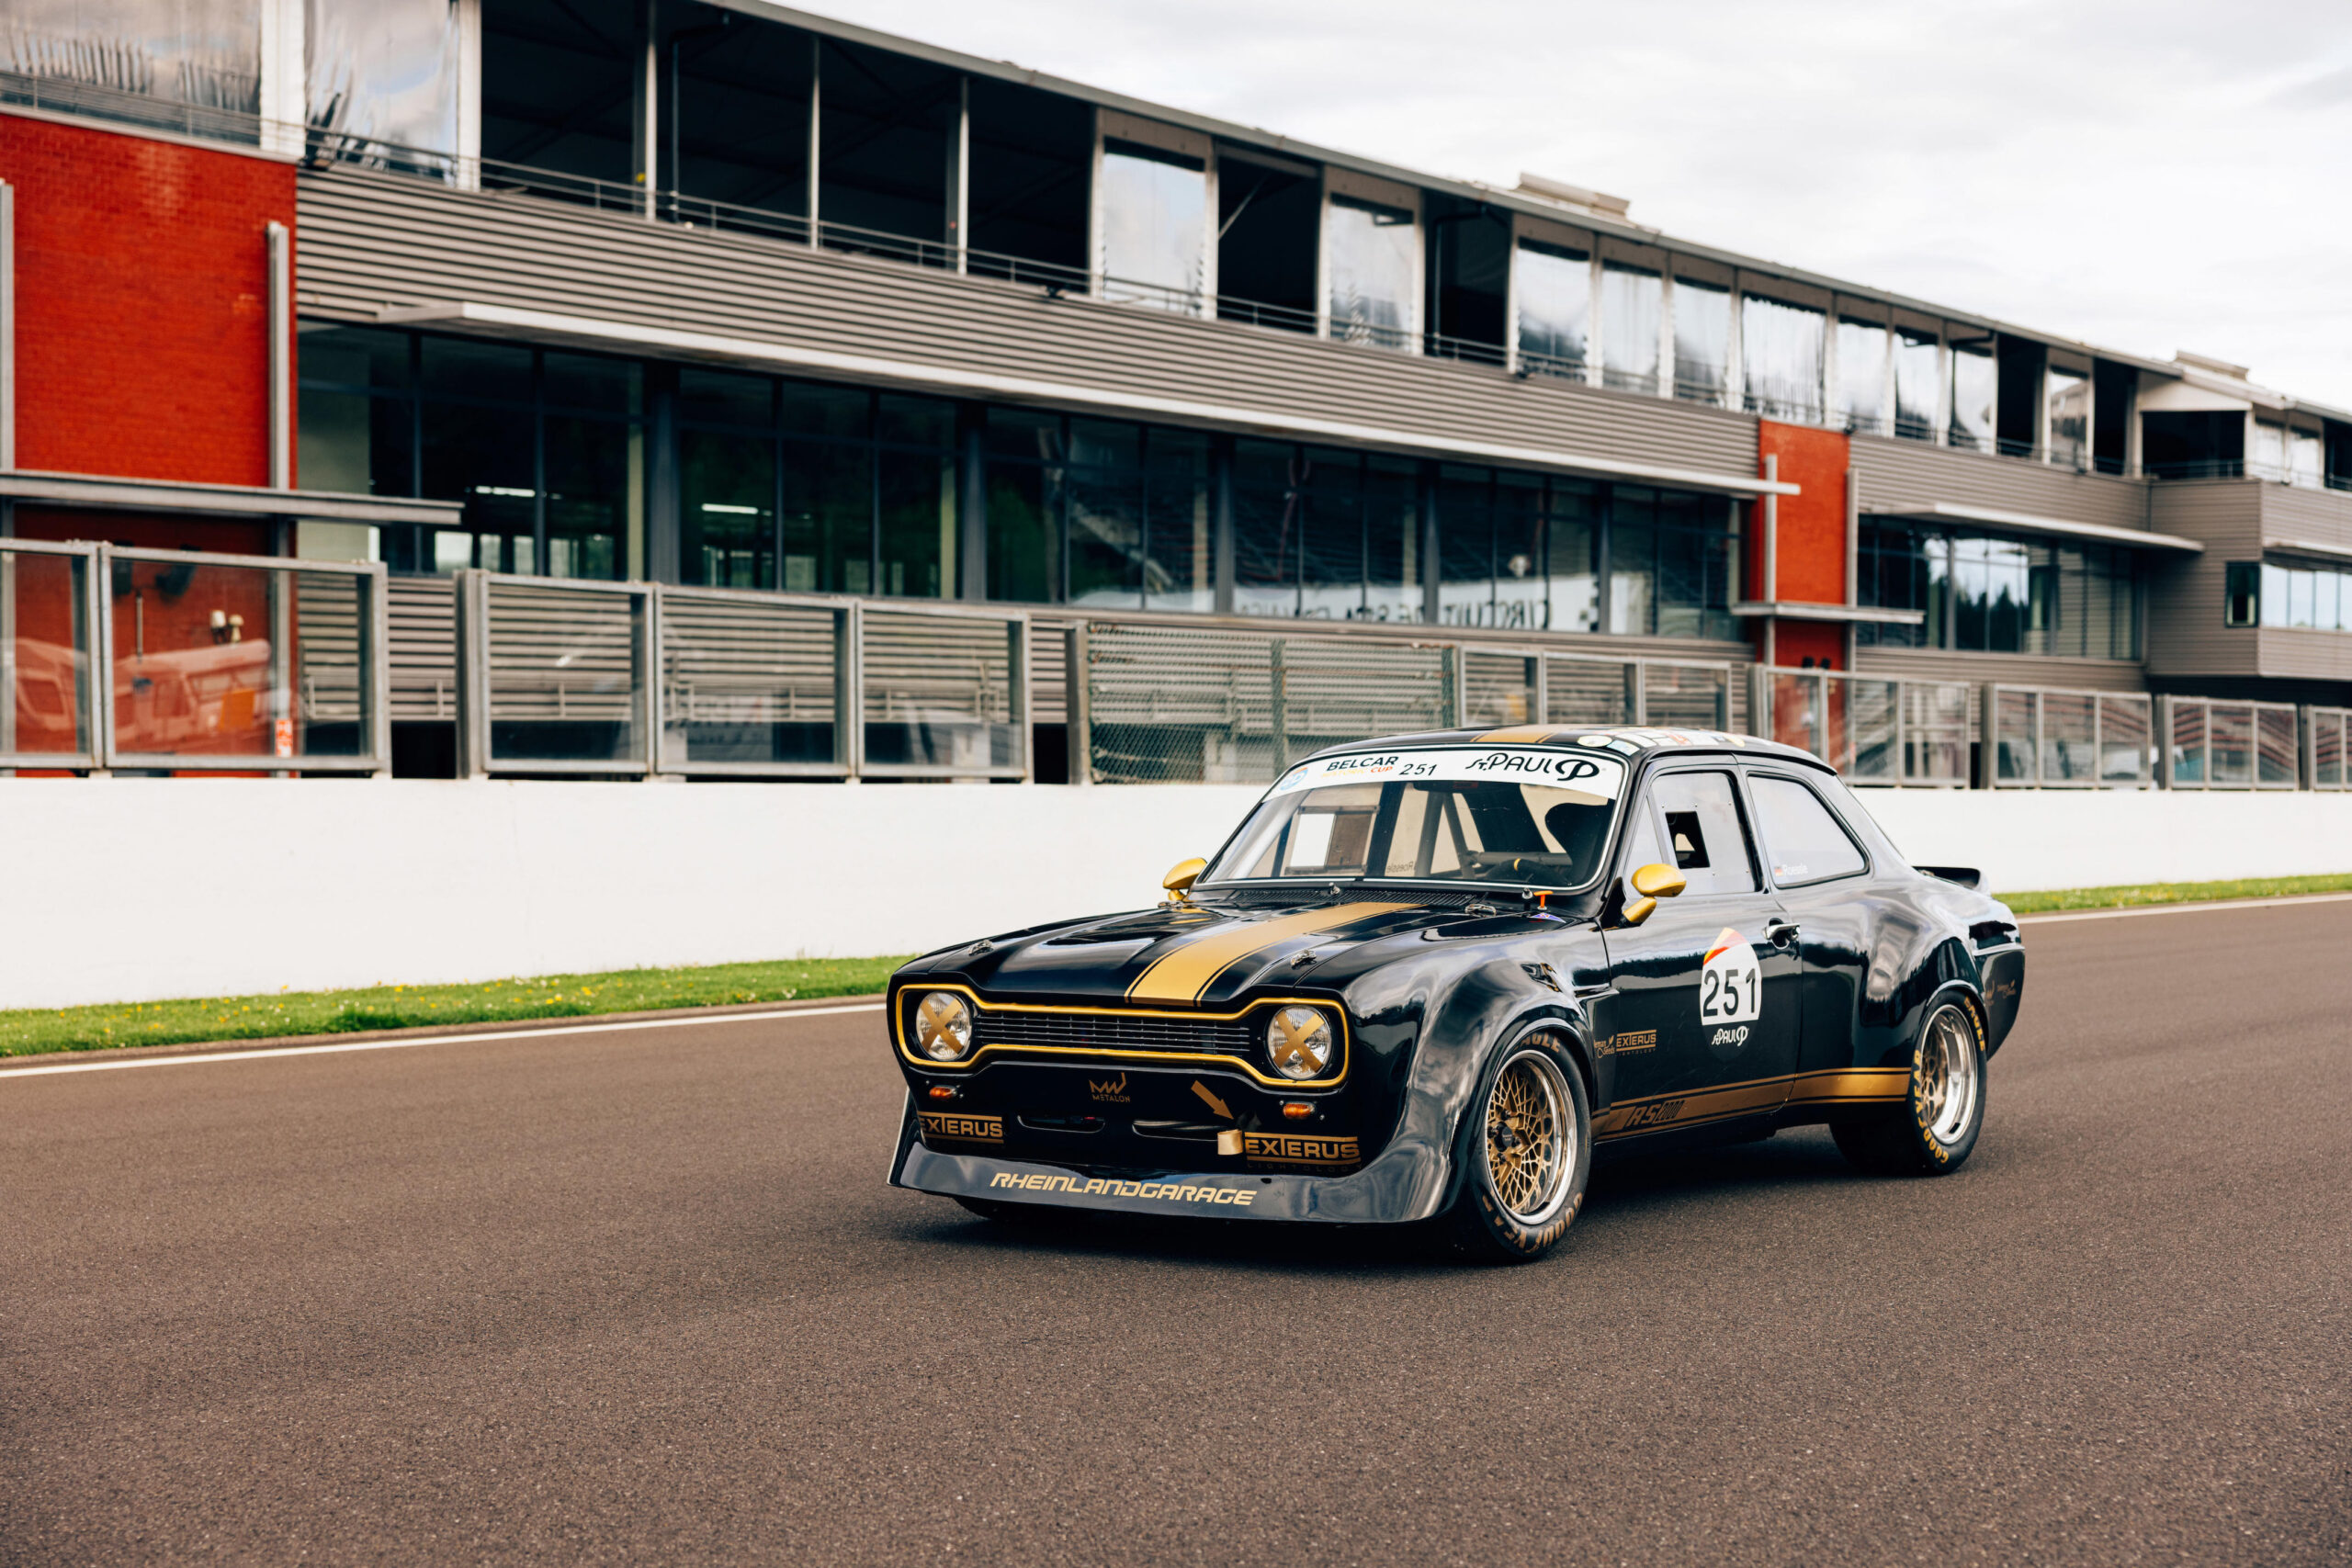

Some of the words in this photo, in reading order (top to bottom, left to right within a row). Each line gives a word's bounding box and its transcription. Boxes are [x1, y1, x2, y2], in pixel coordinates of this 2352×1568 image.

[1327, 756, 1399, 772] BELCAR
[1399, 763, 1439, 776] 251
[1702, 967, 1756, 1017] 251
[1964, 996, 1984, 1051] EAGLE
[1514, 1032, 1561, 1053] AGLE
[1616, 1031, 1657, 1048] EXTERUS
[1091, 1094, 1131, 1103] METALON
[1914, 1050, 1950, 1164] GOODYEAR
[919, 1113, 1003, 1138] EXTERUS
[1244, 1135, 1360, 1160] EXTERUS
[1247, 1162, 1363, 1172] LIGHTOLOGY
[989, 1172, 1258, 1206] RHEINLANDGARAGE
